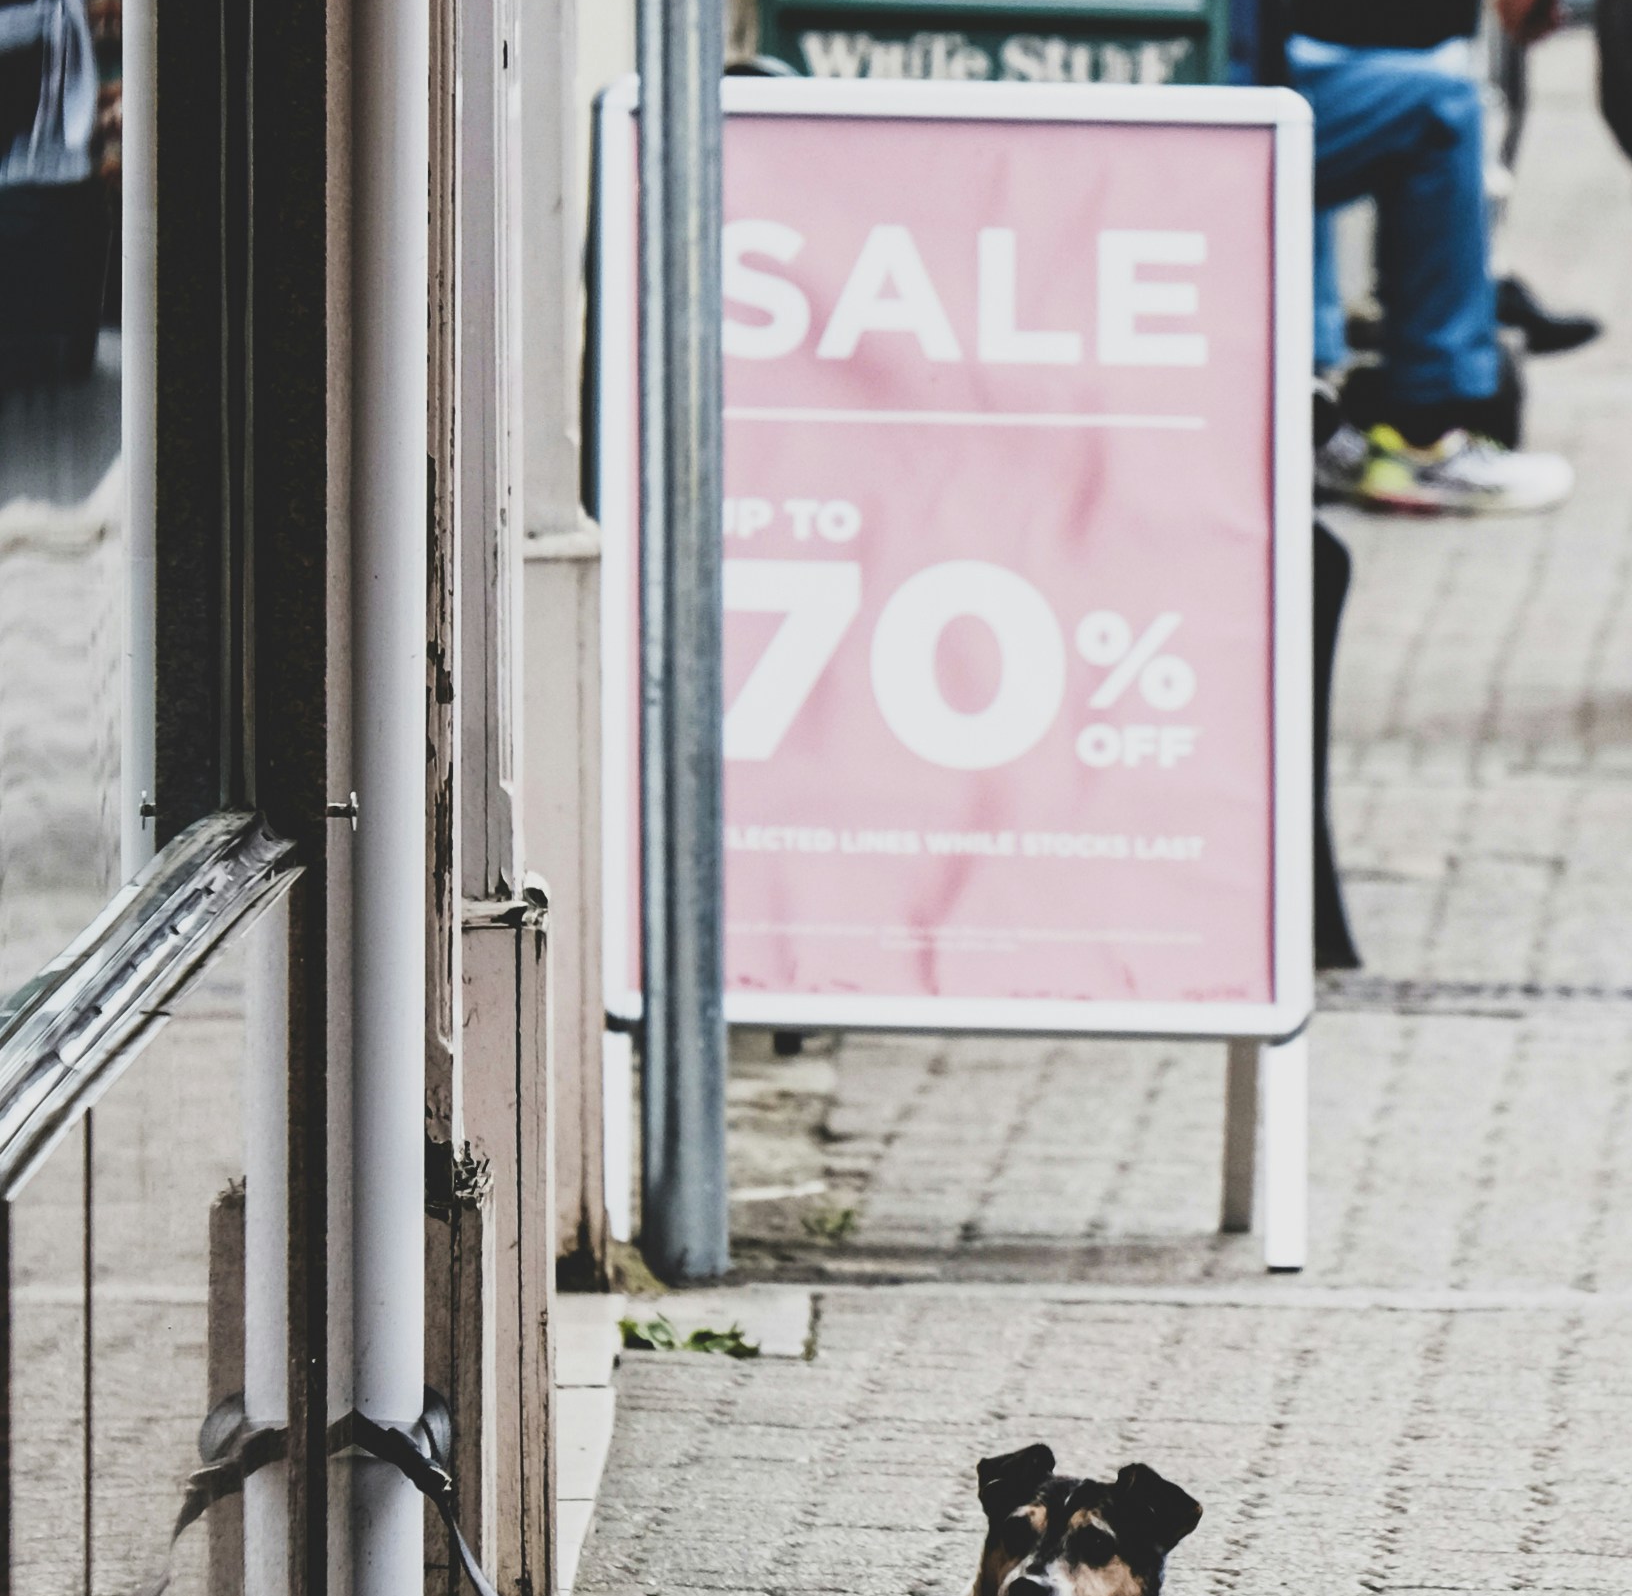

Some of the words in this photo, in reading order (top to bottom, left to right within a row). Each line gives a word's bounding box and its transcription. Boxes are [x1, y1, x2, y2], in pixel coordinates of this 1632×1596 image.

[722, 219, 1208, 366] SALE
[784, 499, 862, 542] TO
[1075, 723, 1200, 768] OFF
[840, 829, 920, 855] LINES
[927, 831, 1014, 857] WHILE
[1022, 833, 1128, 860] STOCKS
[1135, 836, 1206, 860] LAST
